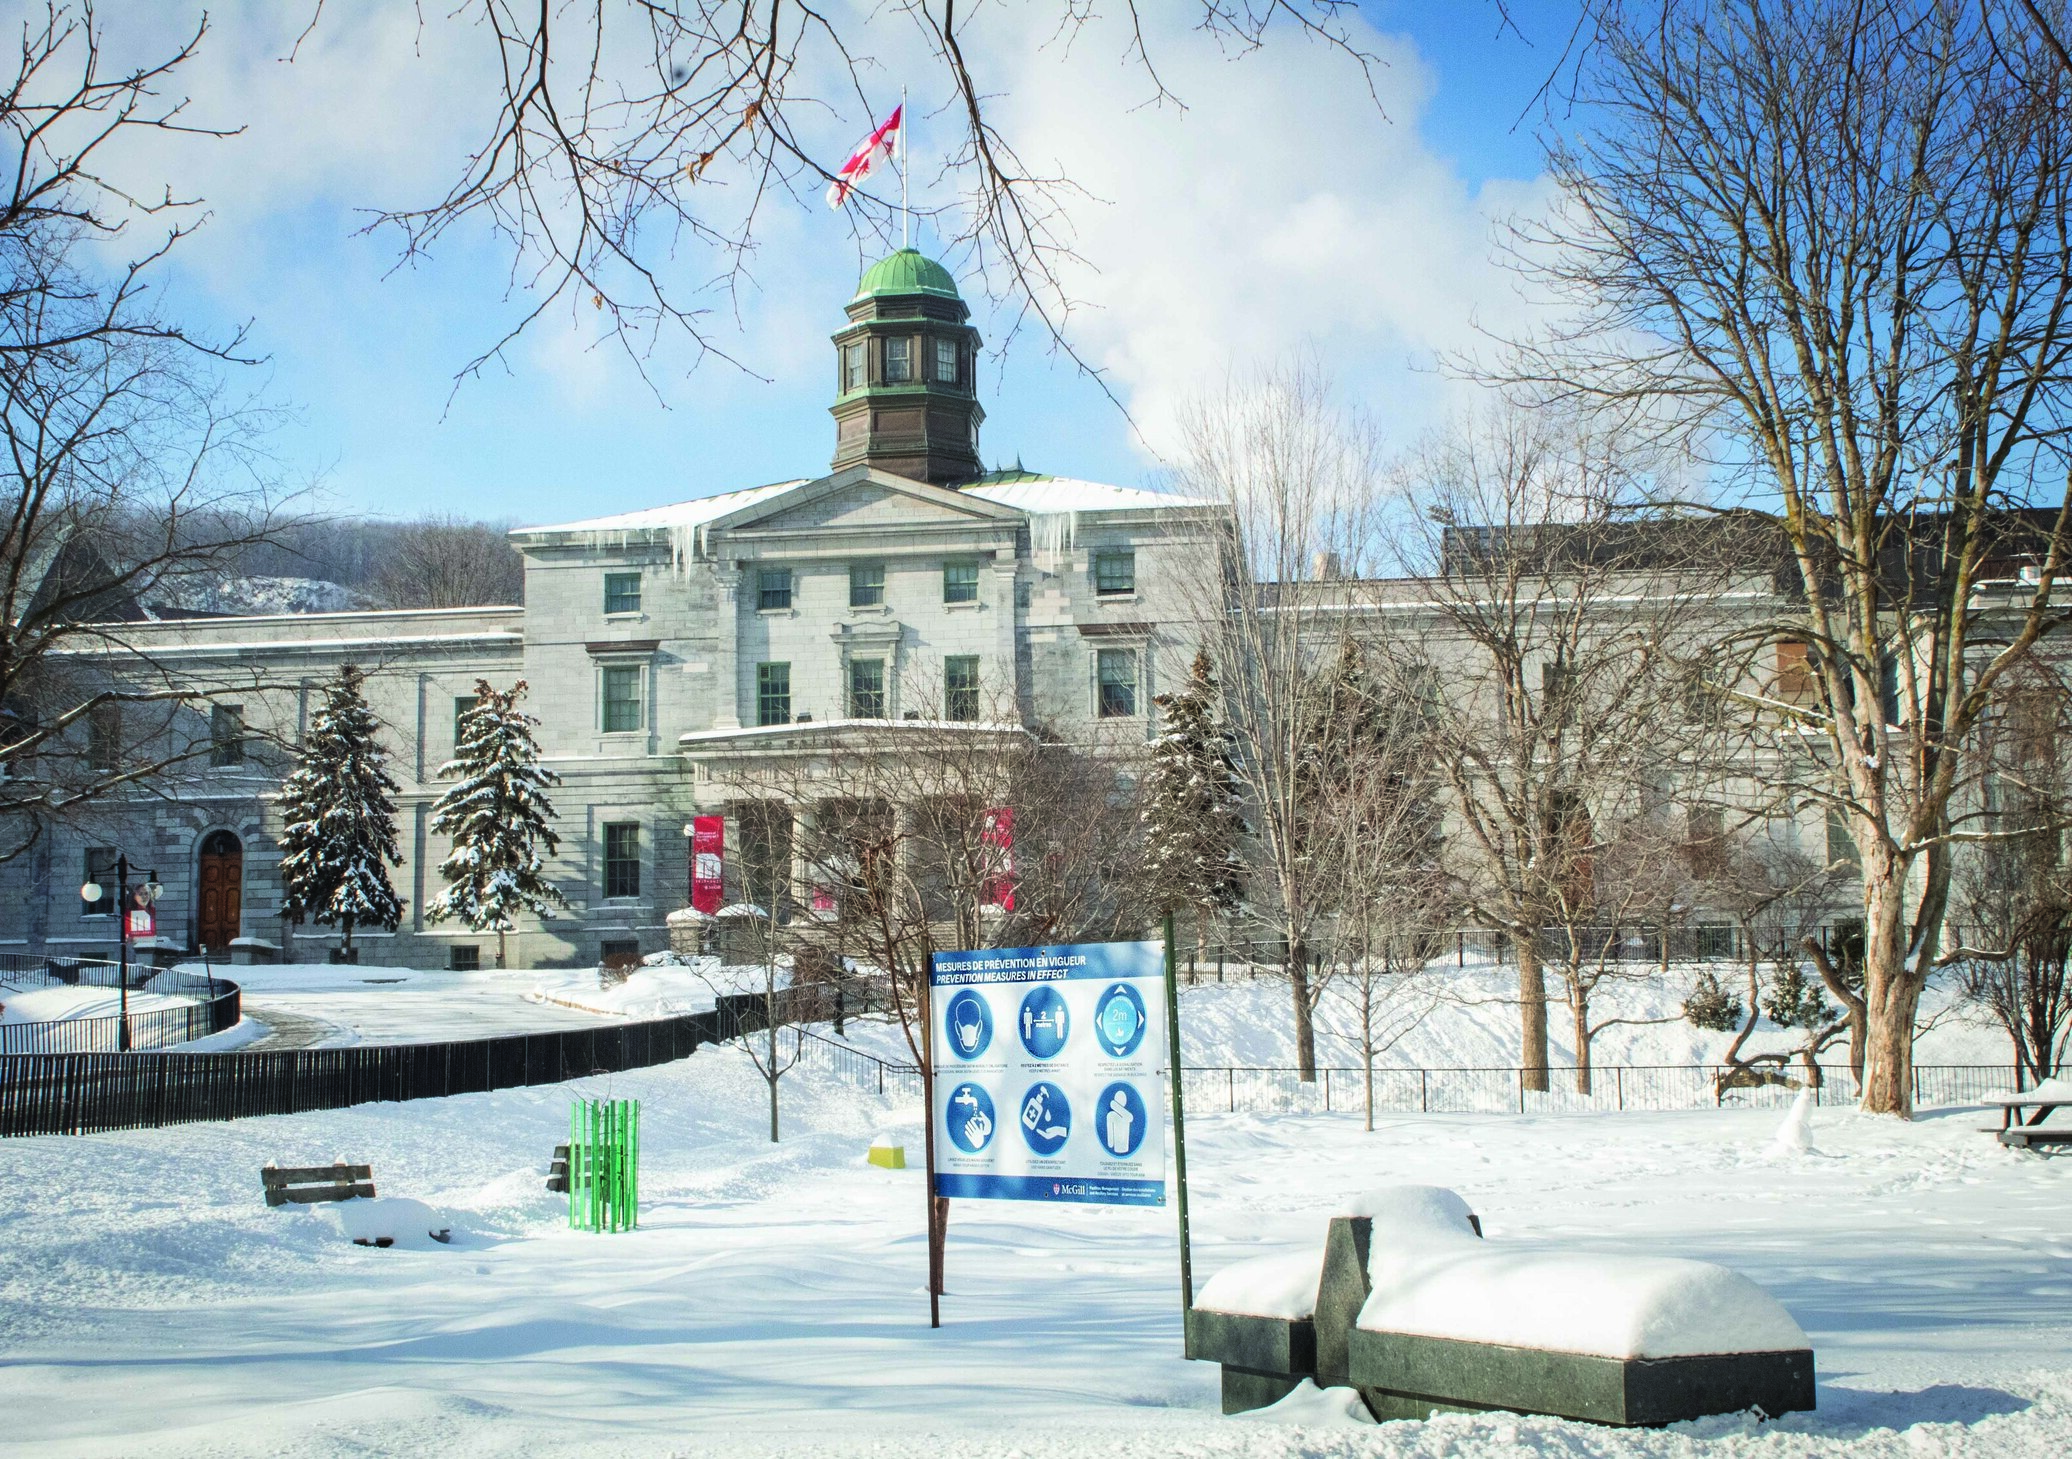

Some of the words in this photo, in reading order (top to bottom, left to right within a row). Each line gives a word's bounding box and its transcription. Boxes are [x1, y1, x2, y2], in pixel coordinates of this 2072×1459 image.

[936, 961, 972, 972] MESURES
[973, 961, 984, 971] DE
[984, 957, 1036, 970] PRÉVENTION
[1036, 957, 1048, 968] EN
[1049, 955, 1086, 967] VIGUEUR
[936, 973, 984, 984] PREVENTION
[984, 971, 1026, 982] MEASURES
[1027, 970, 1036, 980] IN
[1037, 969, 1068, 980] EFFECT
[1040, 1011, 1046, 1019] 2
[1112, 1009, 1128, 1021] 2m
[1061, 1184, 1085, 1195] McGill
